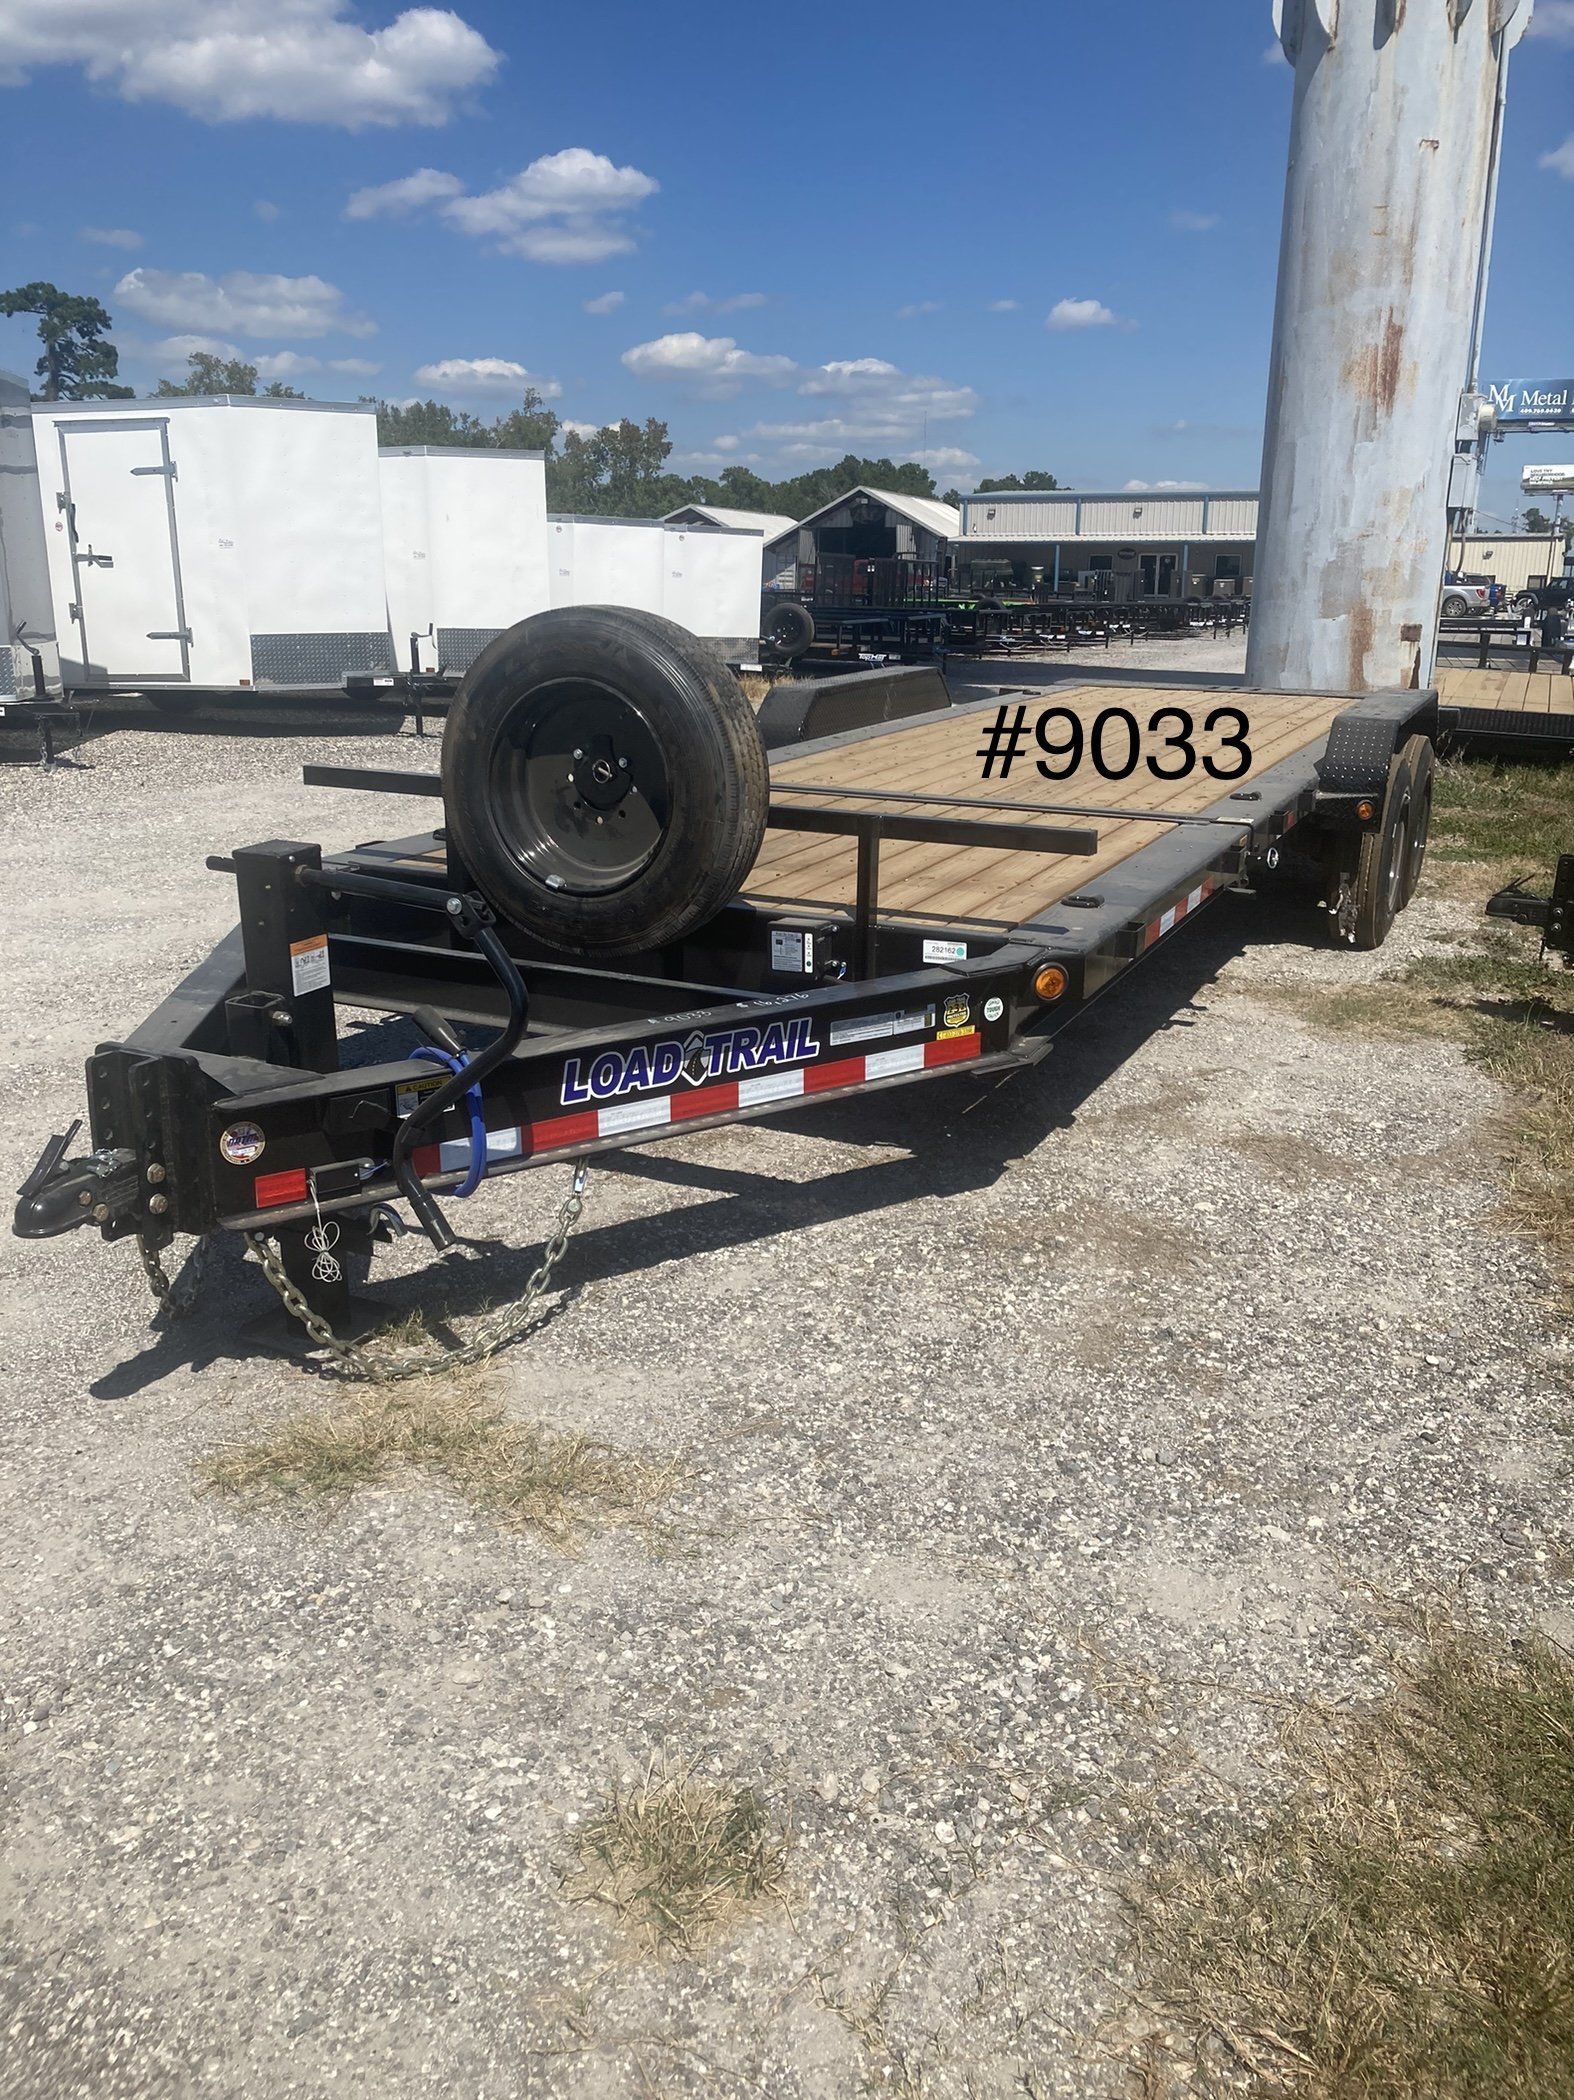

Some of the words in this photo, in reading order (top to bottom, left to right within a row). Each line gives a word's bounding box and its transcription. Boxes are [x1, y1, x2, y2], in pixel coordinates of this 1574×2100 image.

[1520, 390, 1568, 406] Metal
[932, 945, 956, 955] 282162
[664, 1009, 712, 1024] 9033
[561, 1041, 683, 1105] LOAD
[704, 1017, 820, 1077] TRAIL
[412, 1079, 444, 1090] CAUTION
